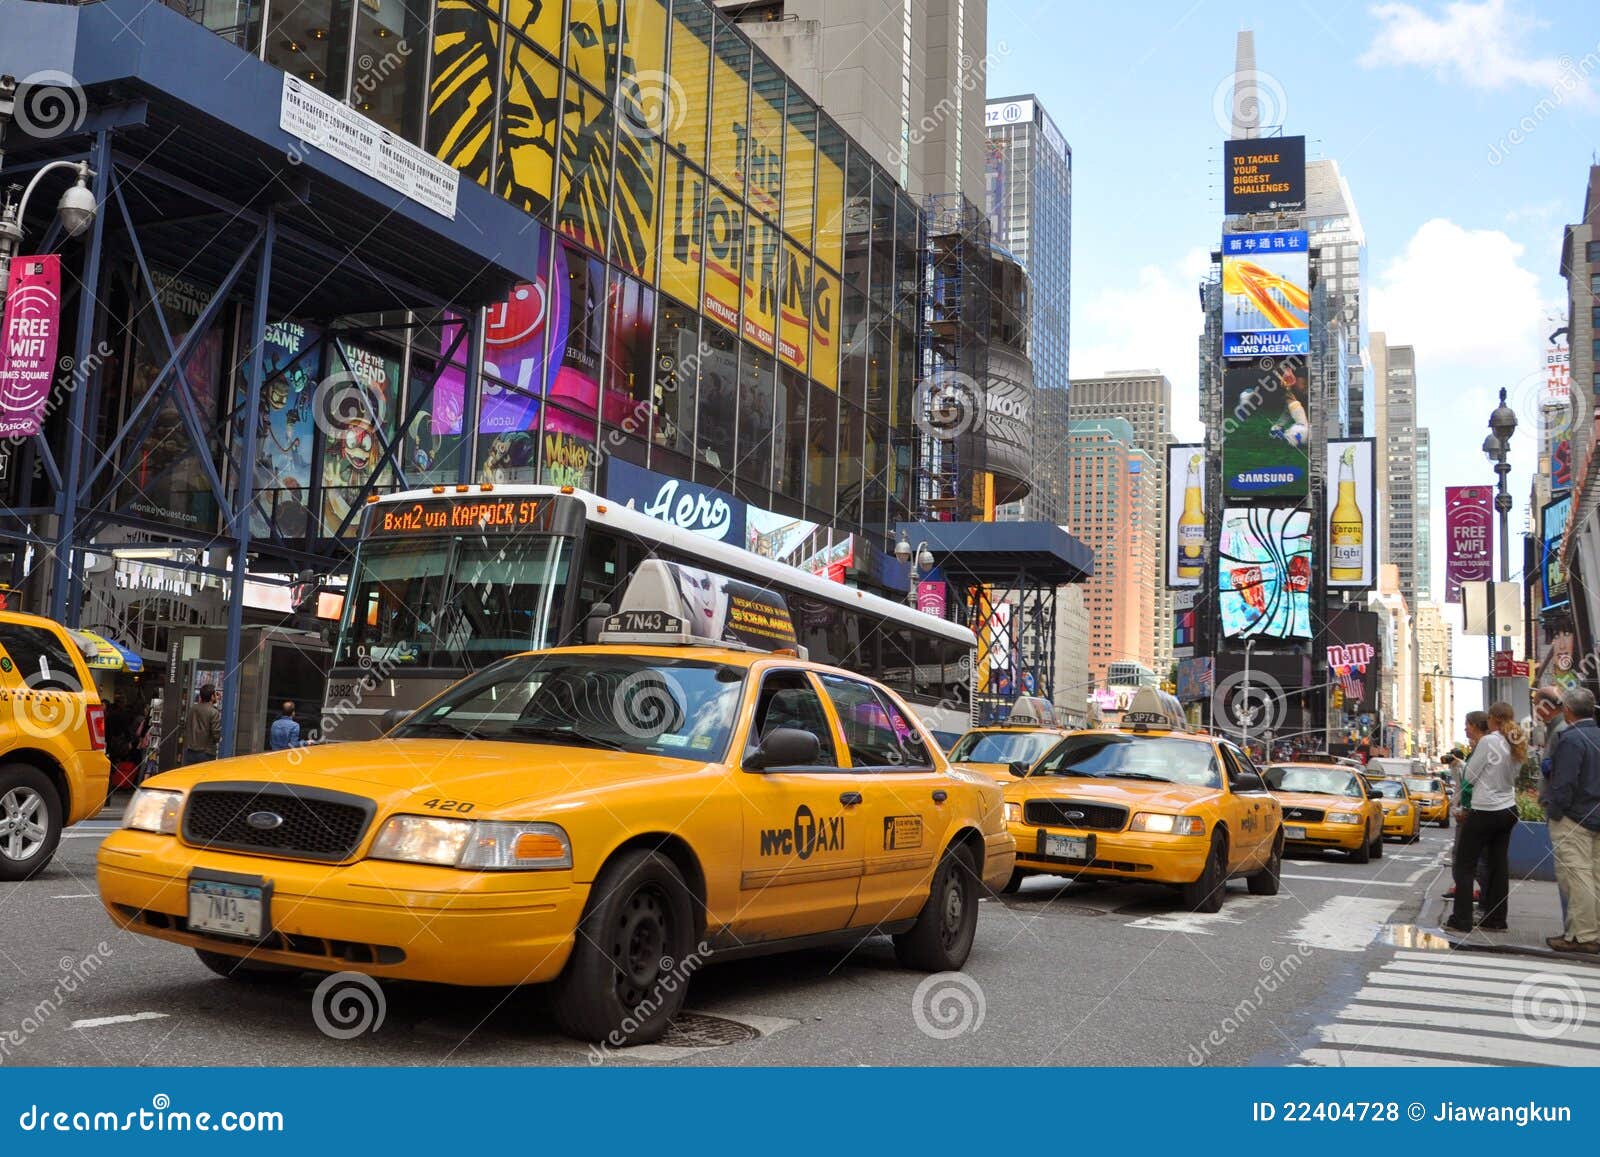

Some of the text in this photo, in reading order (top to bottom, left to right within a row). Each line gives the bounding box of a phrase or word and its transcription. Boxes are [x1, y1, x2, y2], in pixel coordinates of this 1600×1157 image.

[286, 92, 301, 107] YORK
[302, 99, 329, 123] SCAFFOLD
[330, 115, 359, 138] EQUIPMENT
[360, 132, 373, 146] CORP
[732, 119, 781, 199] THE
[1233, 154, 1280, 165] TO TACKLE
[379, 143, 392, 159] YORK
[393, 150, 416, 172] SCAFFOLD
[417, 164, 441, 186] EQUIPMENT
[442, 177, 455, 193] CORP
[1233, 165, 1258, 175] YOUR
[1233, 174, 1271, 185] BIGGEST
[1233, 183, 1290, 195] CHALLENGES
[673, 140, 756, 283] LION
[759, 209, 831, 333] KING
[705, 295, 738, 325] ENTRANCE
[9, 318, 51, 337] FREE
[289, 322, 305, 337] THE
[744, 322, 773, 346] ON 45TH
[264, 325, 300, 354] GAME
[1240, 334, 1291, 346] XINHUA
[9, 338, 46, 358] WIFI
[778, 340, 797, 360] STREET
[1230, 344, 1303, 354] NEWS AGENCY
[11, 360, 39, 369] NOW IN
[347, 345, 385, 369] LIVE THE
[0, 371, 50, 380] TIMES SQUARE
[1238, 472, 1295, 484] SAMSUNG
[383, 504, 424, 531] BxM2
[519, 502, 538, 524] ST
[644, 478, 731, 542] Aero
[1453, 525, 1486, 539] FREE
[1335, 546, 1360, 560] Light
[1456, 539, 1485, 552] WIFI
[1449, 560, 1491, 568] TIMES SQUARE
[921, 606, 941, 616] FREE
[625, 613, 662, 630] 7N43
[169, 642, 179, 683] Newsstand
[1133, 712, 1156, 722] 3P74
[424, 798, 476, 814] 420
[760, 828, 793, 857] NYC
